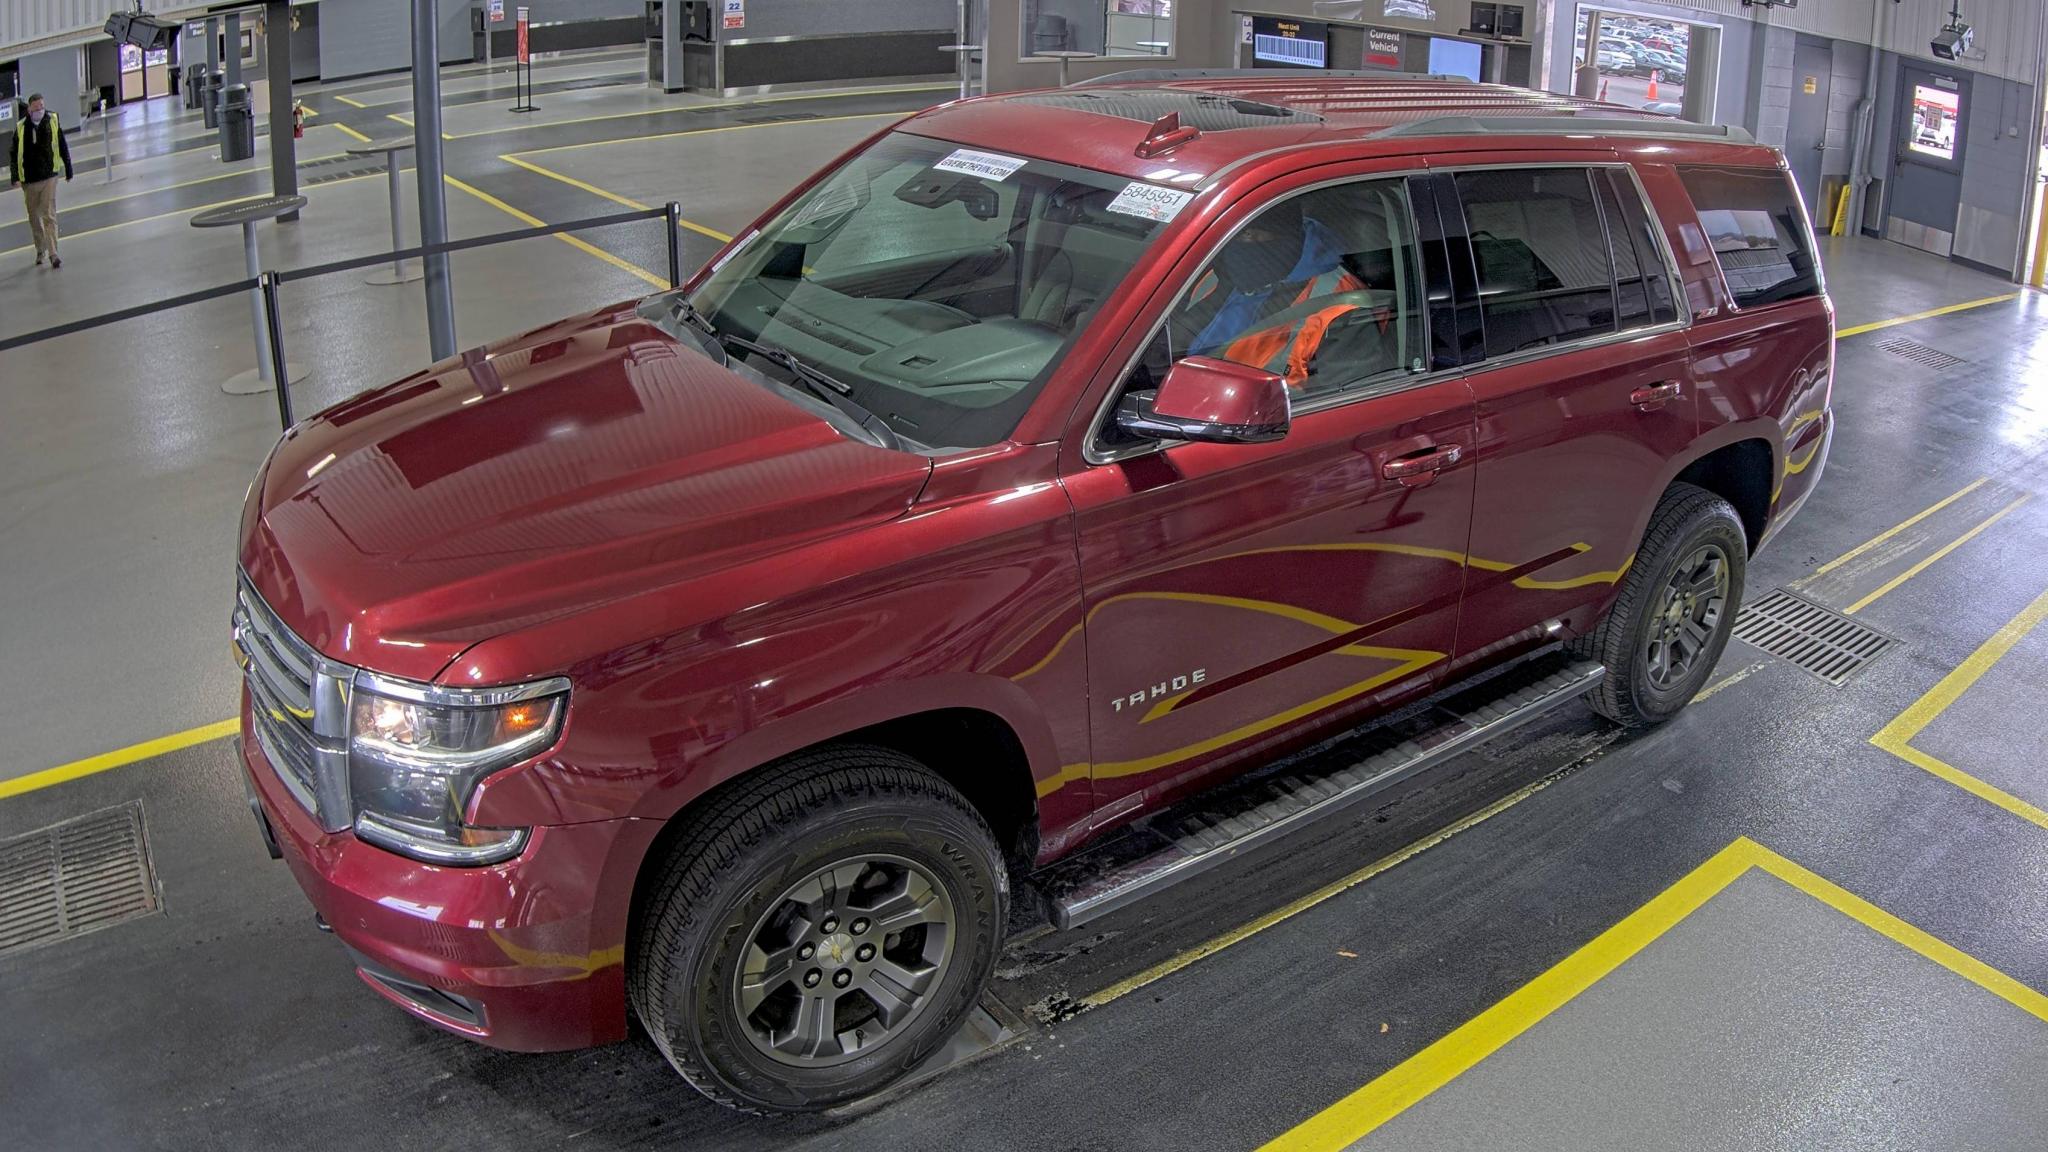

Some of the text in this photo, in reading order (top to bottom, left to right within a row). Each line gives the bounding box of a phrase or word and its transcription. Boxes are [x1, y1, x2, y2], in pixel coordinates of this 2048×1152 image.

[1370, 29, 1400, 41] Current
[1370, 41, 1399, 53] Vehicle
[940, 158, 1012, 177] GIVEMETHEVIN.COM
[1122, 185, 1183, 206] 5845951
[1111, 668, 1206, 713] TAHOE
